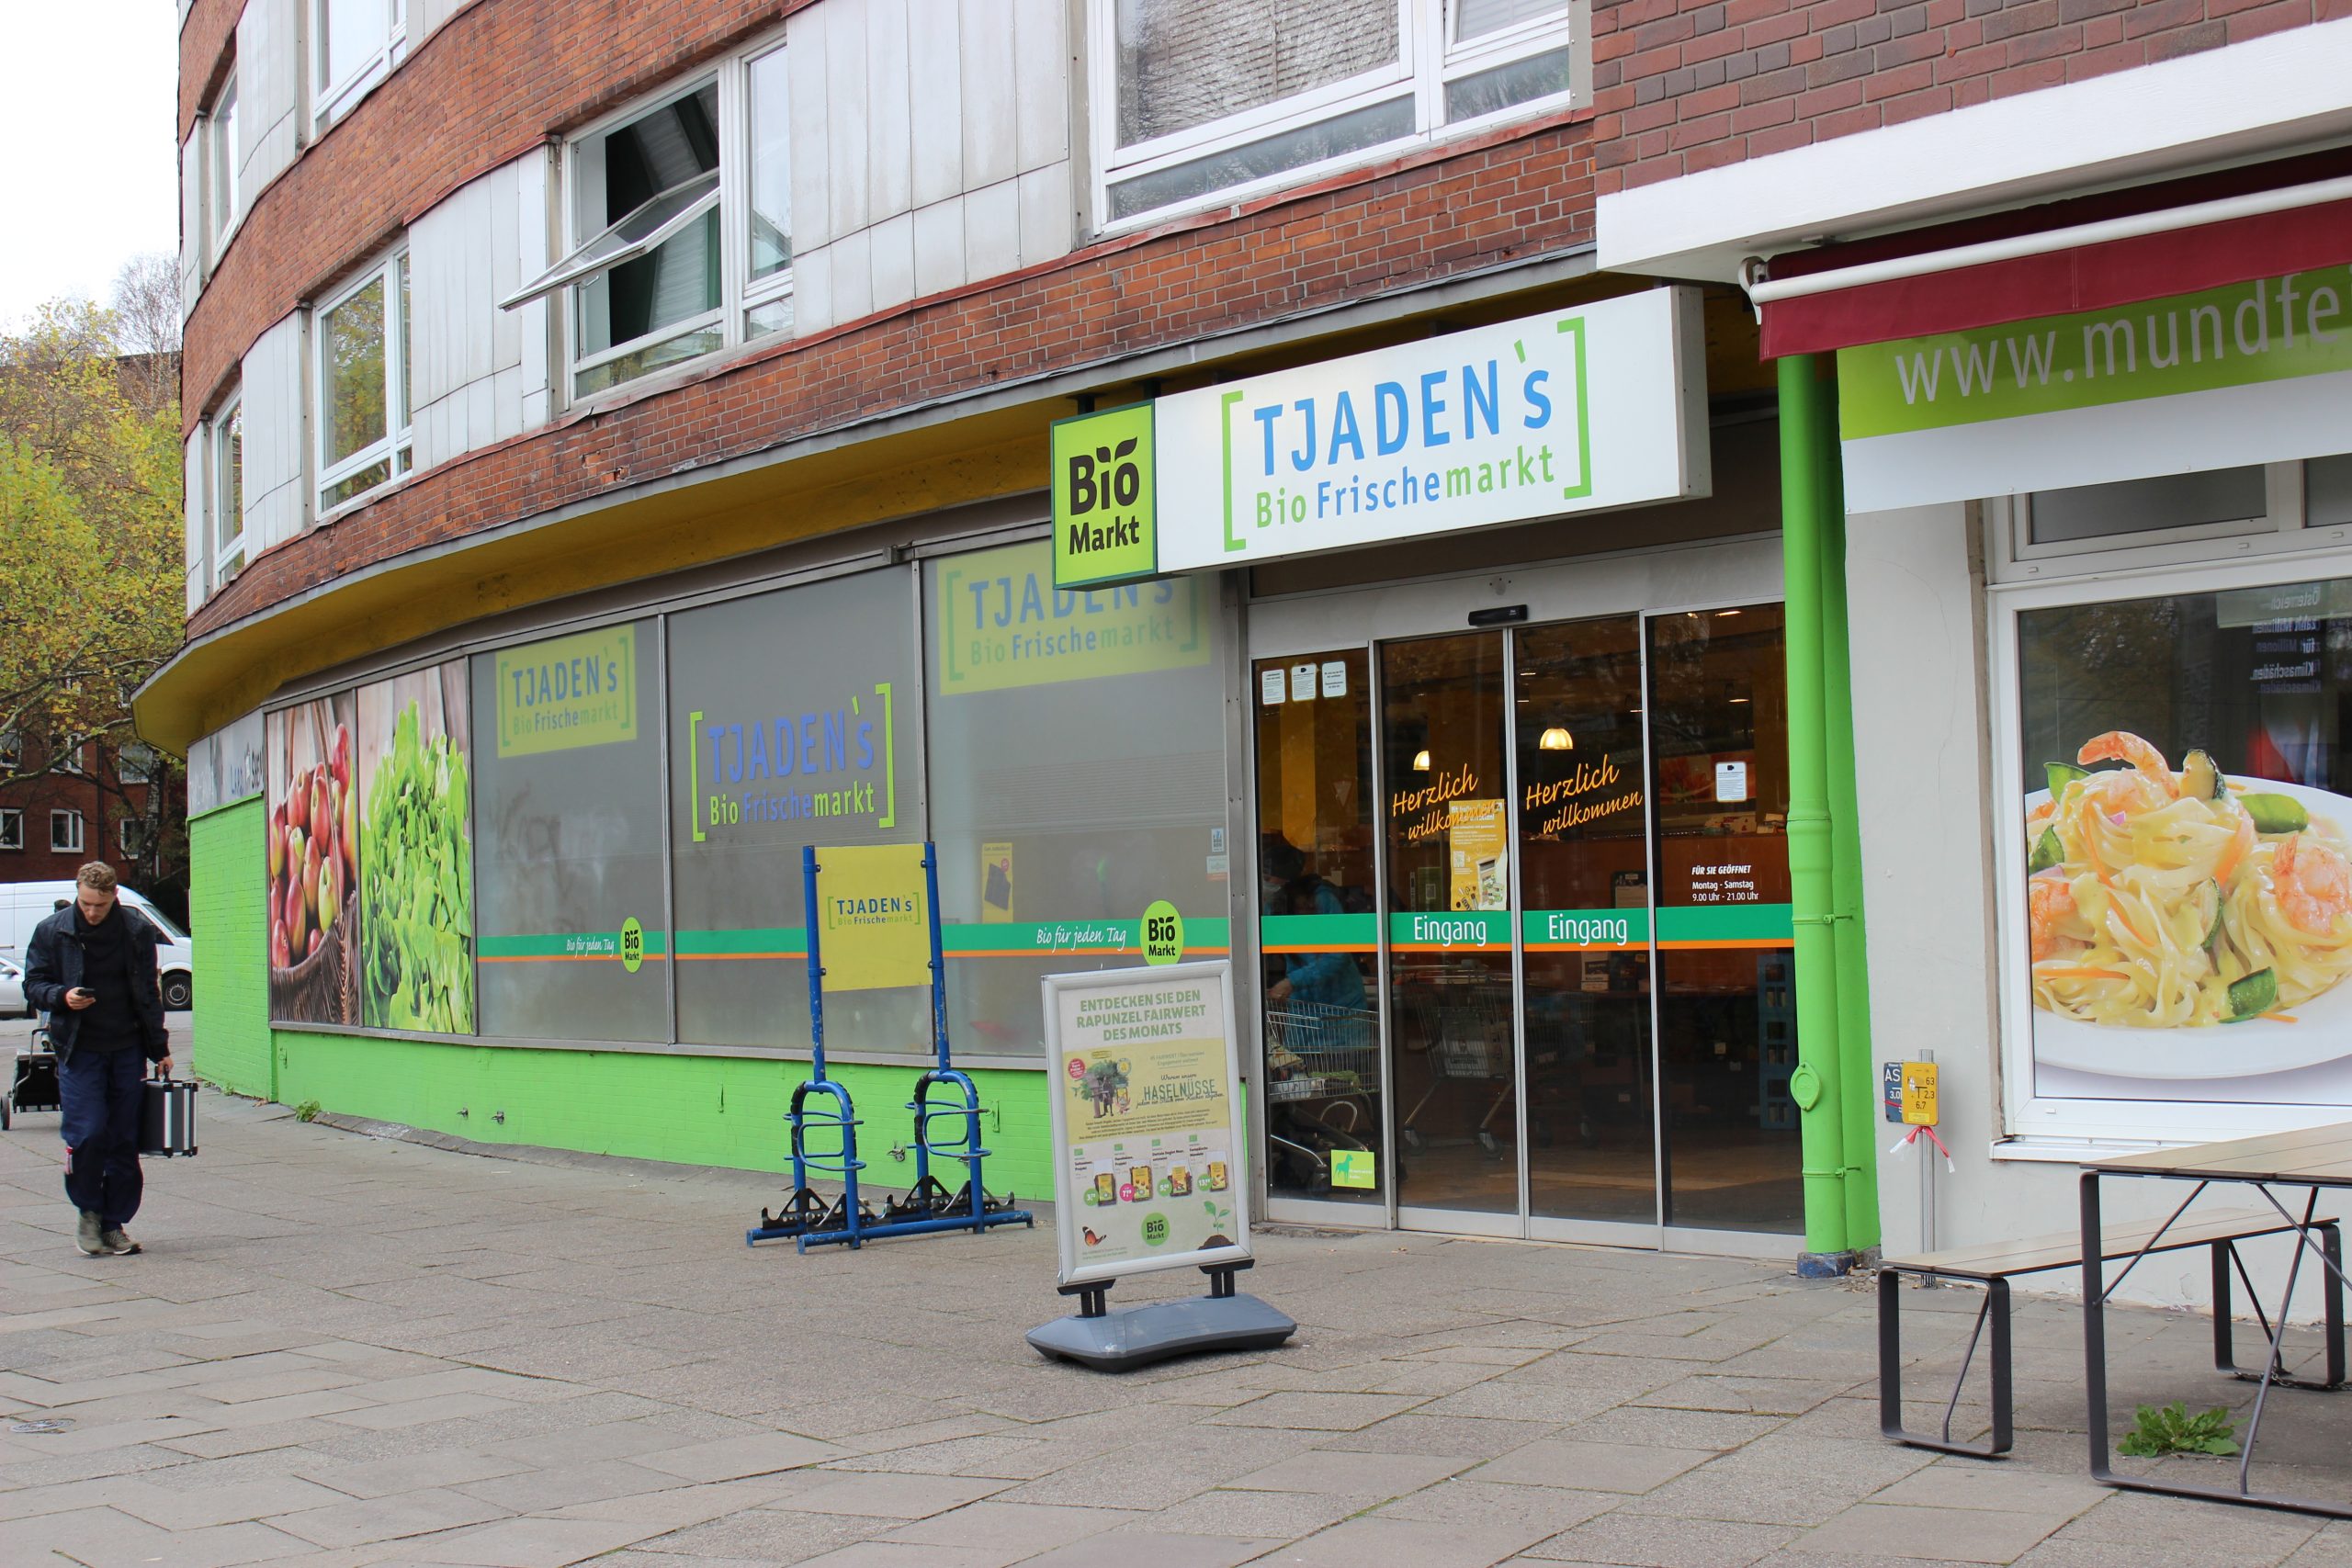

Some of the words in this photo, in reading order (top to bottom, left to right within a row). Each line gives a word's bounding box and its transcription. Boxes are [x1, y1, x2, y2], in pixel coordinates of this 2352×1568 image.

[1894, 265, 2352, 404] www.mundfe
[1069, 437, 1139, 515] Bio
[1256, 487, 1306, 528] Bio
[1317, 444, 1555, 519] Frischemarkt
[1069, 515, 1139, 555] Markt
[971, 639, 1005, 665] Bio
[1012, 615, 1173, 660] Frischemarkt
[513, 715, 532, 736] Bio
[535, 699, 618, 733] Frischemarkt
[1393, 762, 1478, 818] Herzlich
[1526, 754, 1620, 810] Herzlich
[710, 794, 739, 826] Bio
[743, 781, 874, 824] Frischemarkt
[1544, 791, 1643, 834] willkommen
[1408, 799, 1499, 840] willkommen
[1691, 865, 1705, 875] FÜR
[1706, 866, 1717, 874] SIE
[1718, 864, 1751, 874] GEÖFFNET
[1692, 881, 1718, 892] Montag
[1724, 880, 1754, 890] Samstag
[1692, 893, 1707, 902] 9.00
[1709, 892, 1720, 901] Uhr
[1727, 892, 1746, 900] 21.00
[1747, 891, 1758, 900] Uhr
[854, 914, 912, 925] Frischemarkt
[1148, 917, 1175, 942] Bio
[1414, 916, 1487, 947] Eingang
[1548, 914, 1627, 946] Eingang
[567, 938, 575, 952] Bio
[584, 936, 603, 957] jeden
[603, 939, 615, 958] Tag
[625, 930, 639, 949] Bio
[1036, 927, 1052, 944] Bio
[1052, 925, 1071, 953] für
[1070, 924, 1103, 951] jeden
[1106, 927, 1126, 951] Tag
[1148, 944, 1175, 956] Markt
[625, 952, 639, 961] Markt
[1080, 994, 1153, 1011] ENTDECKEN
[1155, 992, 1173, 1005] SIE
[1176, 989, 1201, 1003] DEN
[1076, 1010, 1142, 1028] RAPUNZEL
[1144, 1004, 1206, 1021] FAIRWERT
[1103, 1028, 1127, 1041] DES
[1129, 1021, 1182, 1039] MONATS
[1143, 1078, 1216, 1100] HASELNÜSSE
[1924, 1090, 1935, 1099] 2.3
[1916, 1101, 1927, 1110] 6.7
[1147, 1221, 1164, 1233] Bio
